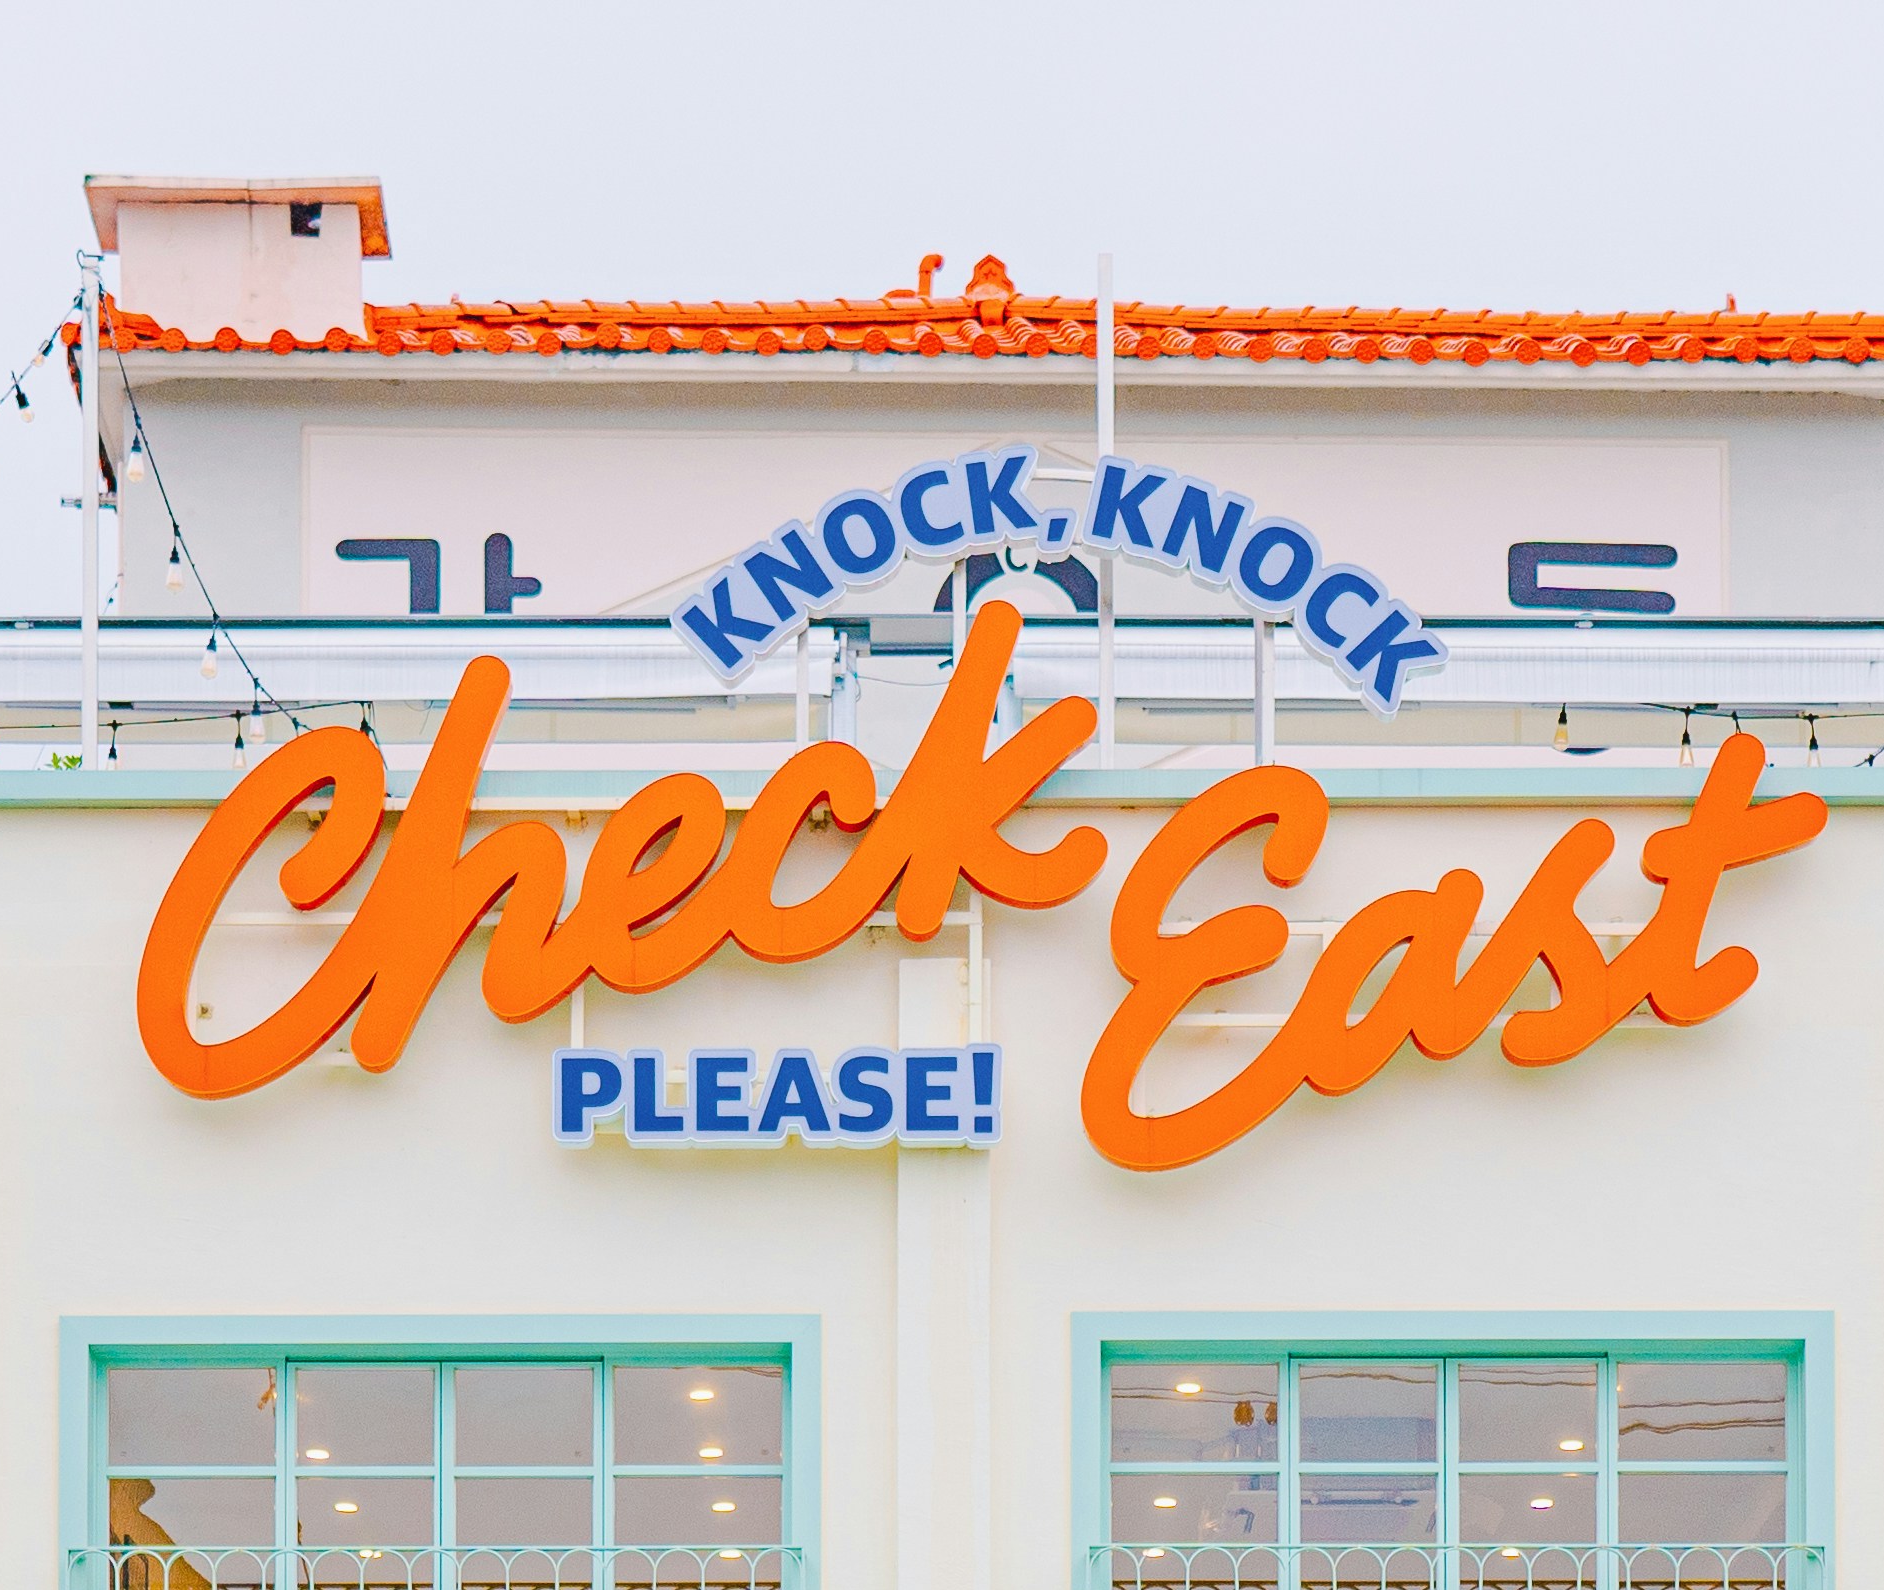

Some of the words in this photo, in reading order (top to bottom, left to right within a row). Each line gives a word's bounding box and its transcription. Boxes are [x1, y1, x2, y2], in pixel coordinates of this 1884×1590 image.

[683, 456, 1068, 668] KNOCK,
[1091, 465, 1436, 703] KNOCK
[137, 600, 1108, 1102] Check
[1080, 732, 1829, 1173] East
[561, 1052, 994, 1133] PLEASE!
